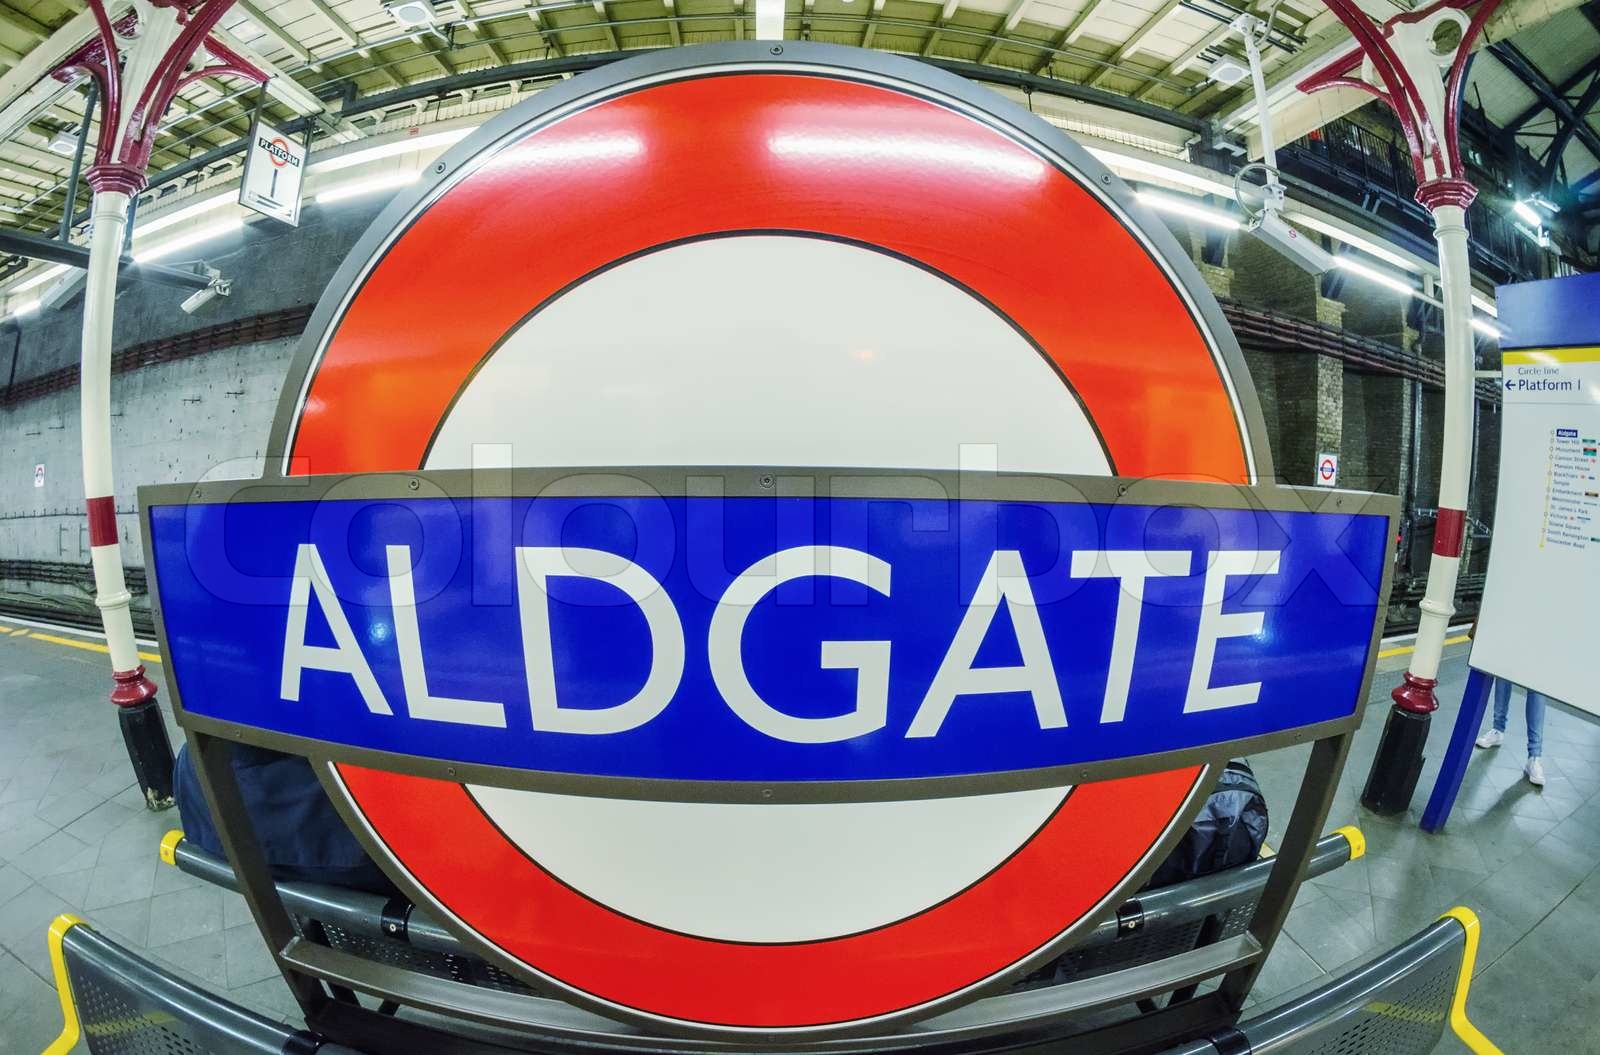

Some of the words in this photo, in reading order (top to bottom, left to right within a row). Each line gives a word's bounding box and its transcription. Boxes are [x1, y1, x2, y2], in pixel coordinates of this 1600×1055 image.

[260, 139, 300, 167] PLATFORM
[1518, 367, 1541, 376] Circle
[1543, 367, 1560, 376] line
[1518, 379, 1572, 391] Platform
[280, 543, 1281, 744] ALDGATE
